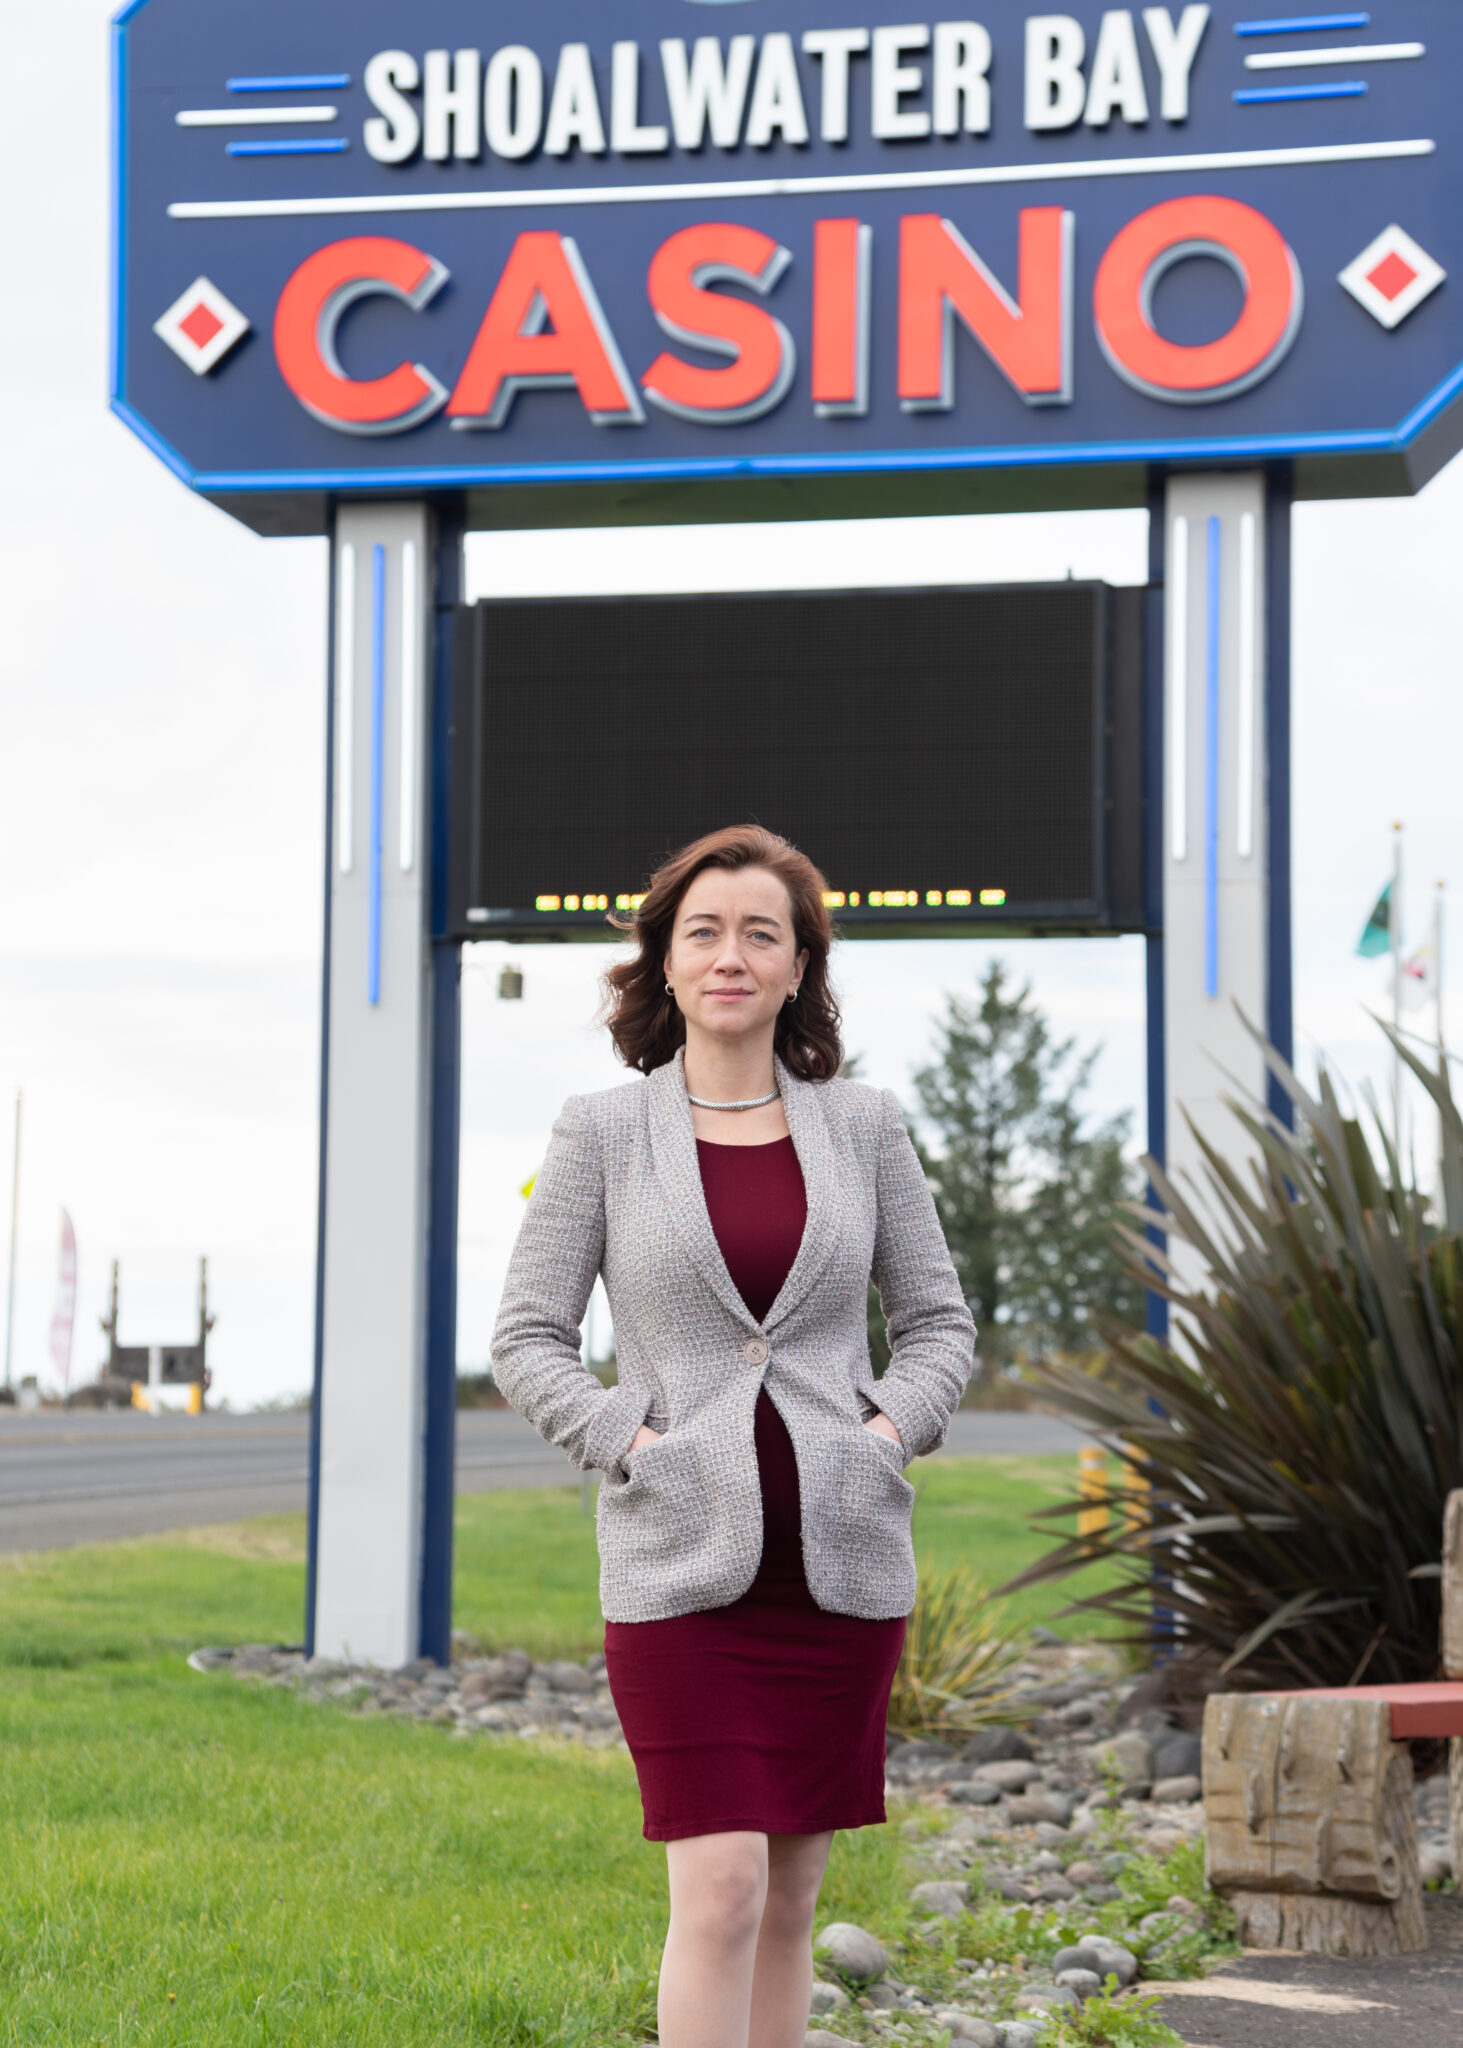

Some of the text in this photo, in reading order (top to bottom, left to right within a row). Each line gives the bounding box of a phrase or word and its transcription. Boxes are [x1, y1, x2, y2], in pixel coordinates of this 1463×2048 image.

[363, 3, 1211, 165] SHOALWATER BAY
[272, 193, 1305, 436] CASINO
